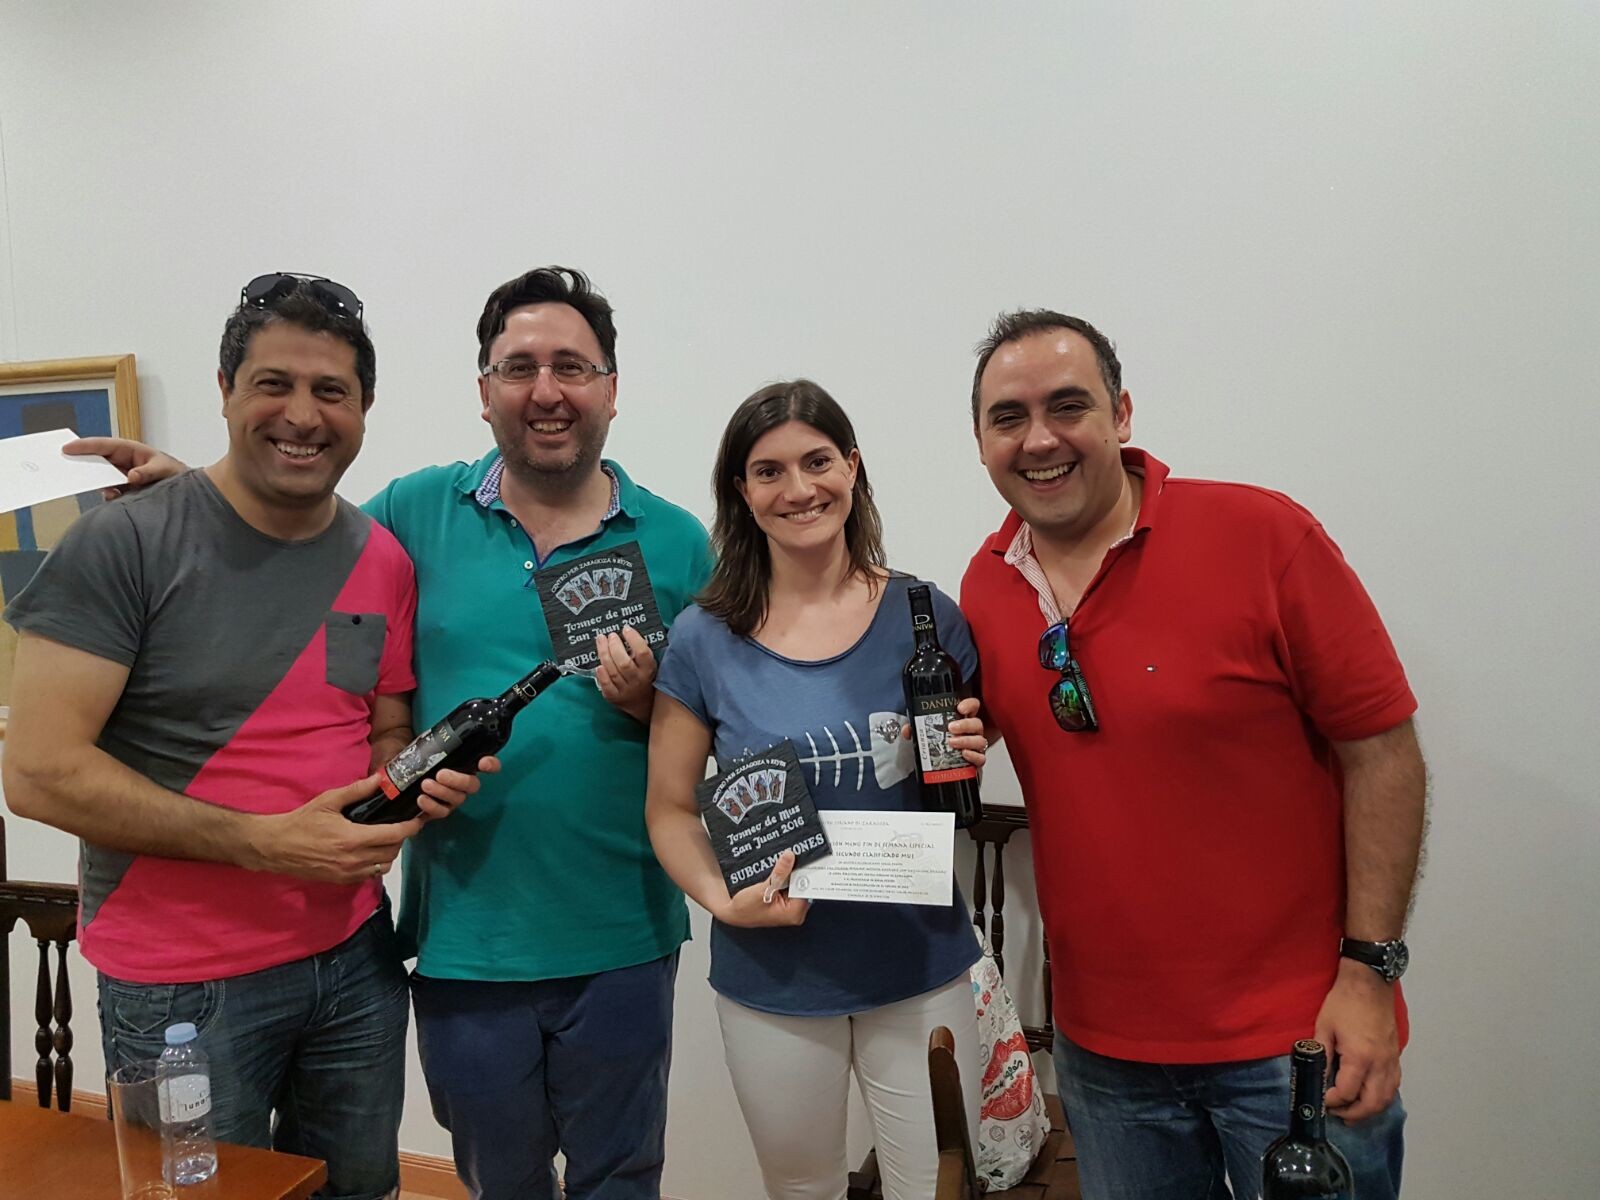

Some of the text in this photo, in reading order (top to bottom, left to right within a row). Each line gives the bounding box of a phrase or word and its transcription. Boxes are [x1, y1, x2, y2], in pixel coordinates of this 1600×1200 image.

[579, 558, 612, 569] ZARAGOZA
[605, 610, 619, 620] de
[621, 603, 644, 617] Mus
[914, 614, 930, 625] D
[568, 613, 647, 645] San Juan 2016
[735, 759, 766, 775] ZARAGOZA
[764, 815, 777, 826] de
[779, 804, 801, 821] Mus
[732, 815, 805, 858] San Juan 2016
[730, 834, 824, 884] SUBCAMONES
